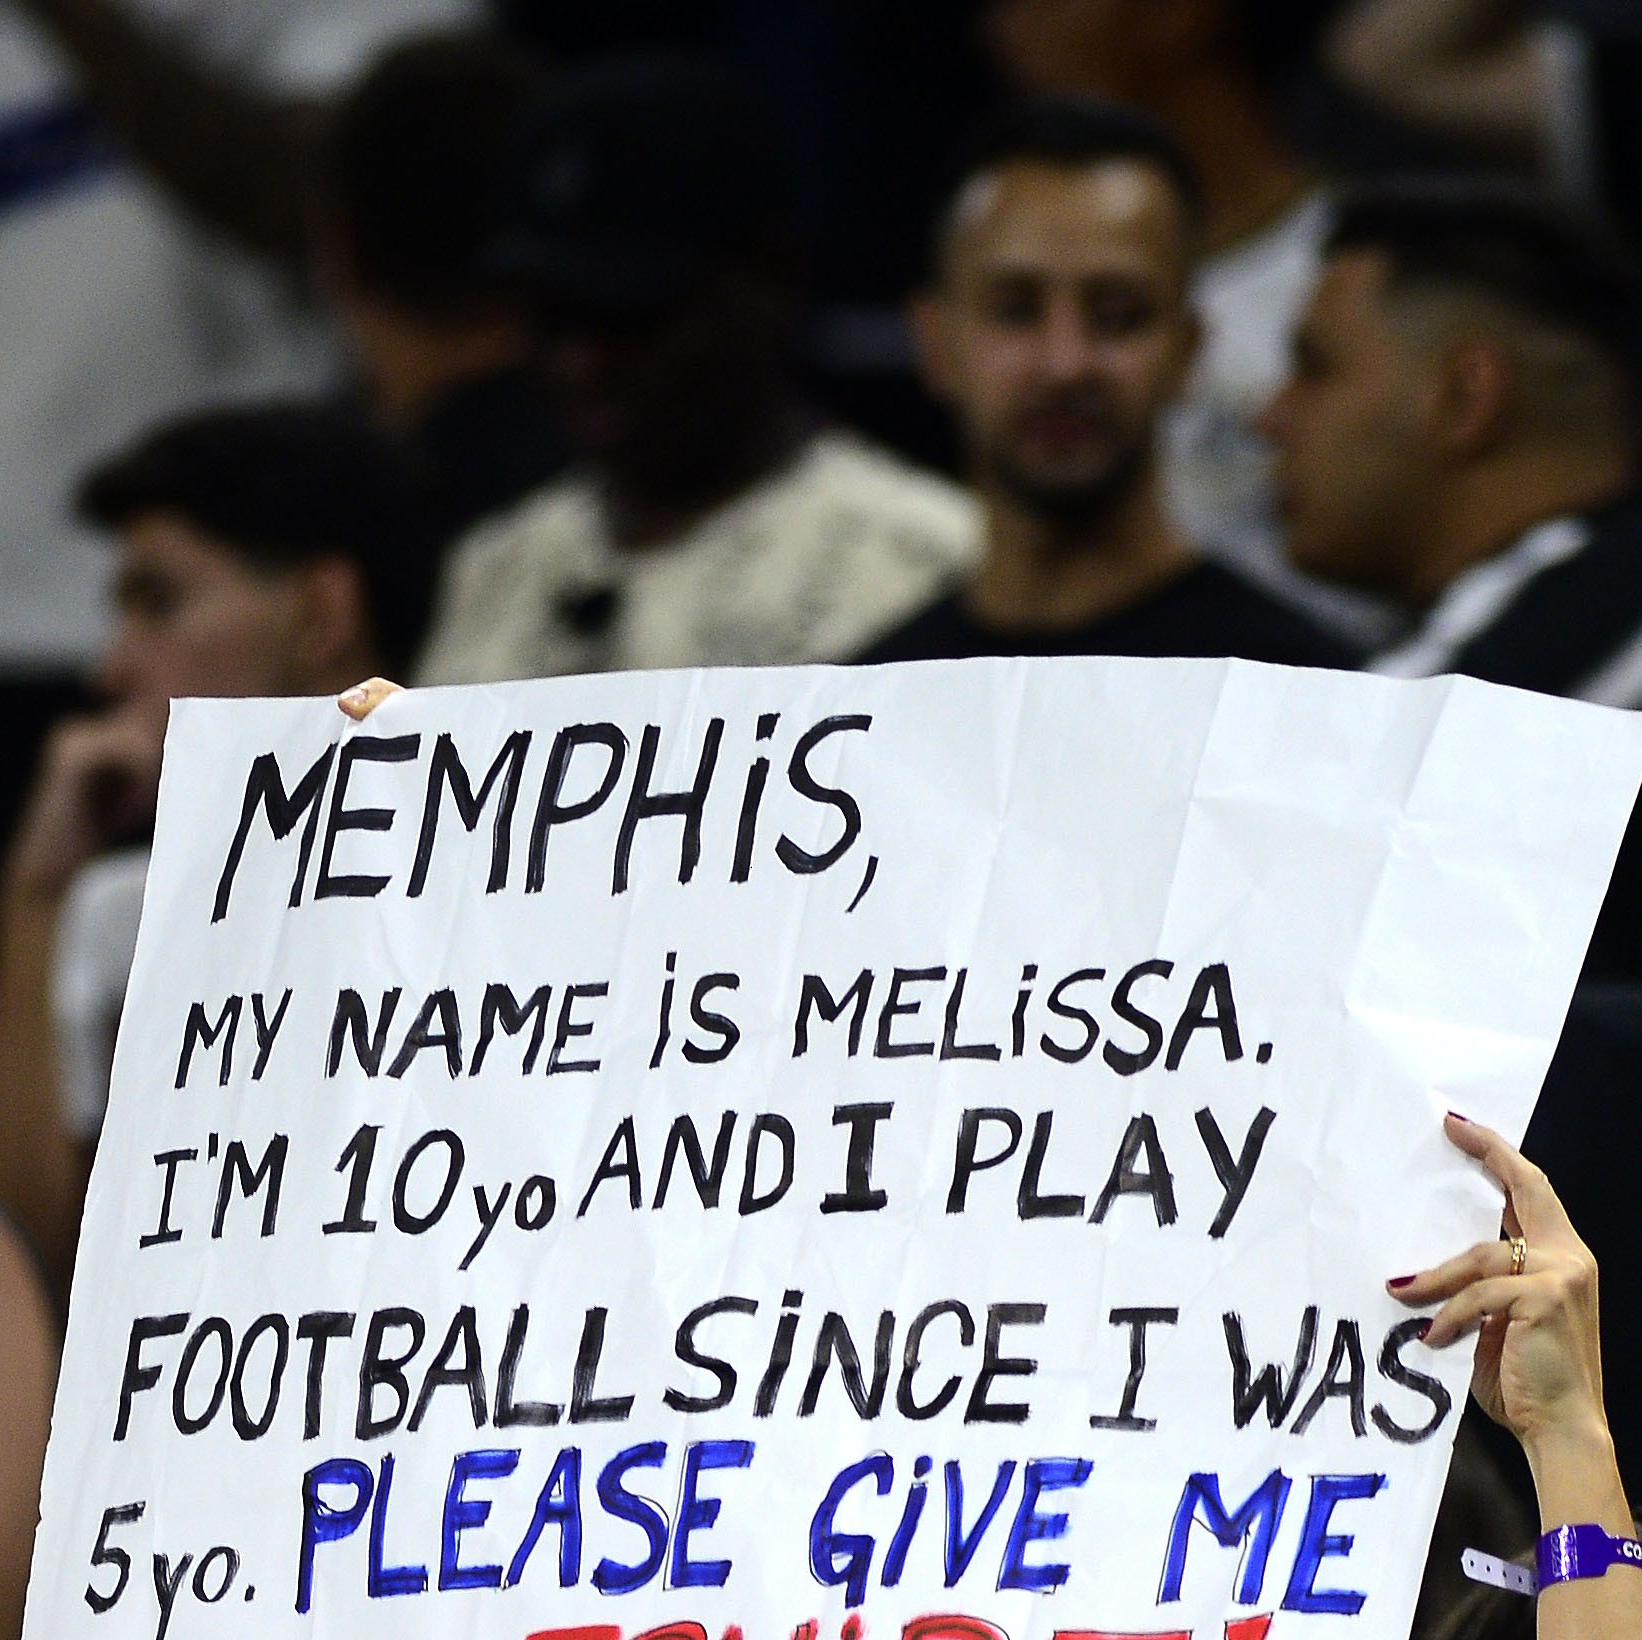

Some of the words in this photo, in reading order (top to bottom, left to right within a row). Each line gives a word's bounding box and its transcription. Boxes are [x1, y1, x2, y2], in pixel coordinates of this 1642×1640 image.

[174, 985, 293, 1090] MY
[324, 981, 610, 1080] NAME
[139, 1131, 290, 1249] I'M
[576, 1110, 796, 1219] AND
[819, 1101, 895, 1216] I
[945, 1106, 1278, 1240] PLAY
[112, 1303, 636, 1442] FOOTBALL
[1089, 1307, 1180, 1432] I
[1222, 1304, 1453, 1445] WAS
[294, 1440, 757, 1615] PLEASE
[1156, 1466, 1390, 1615] ME
